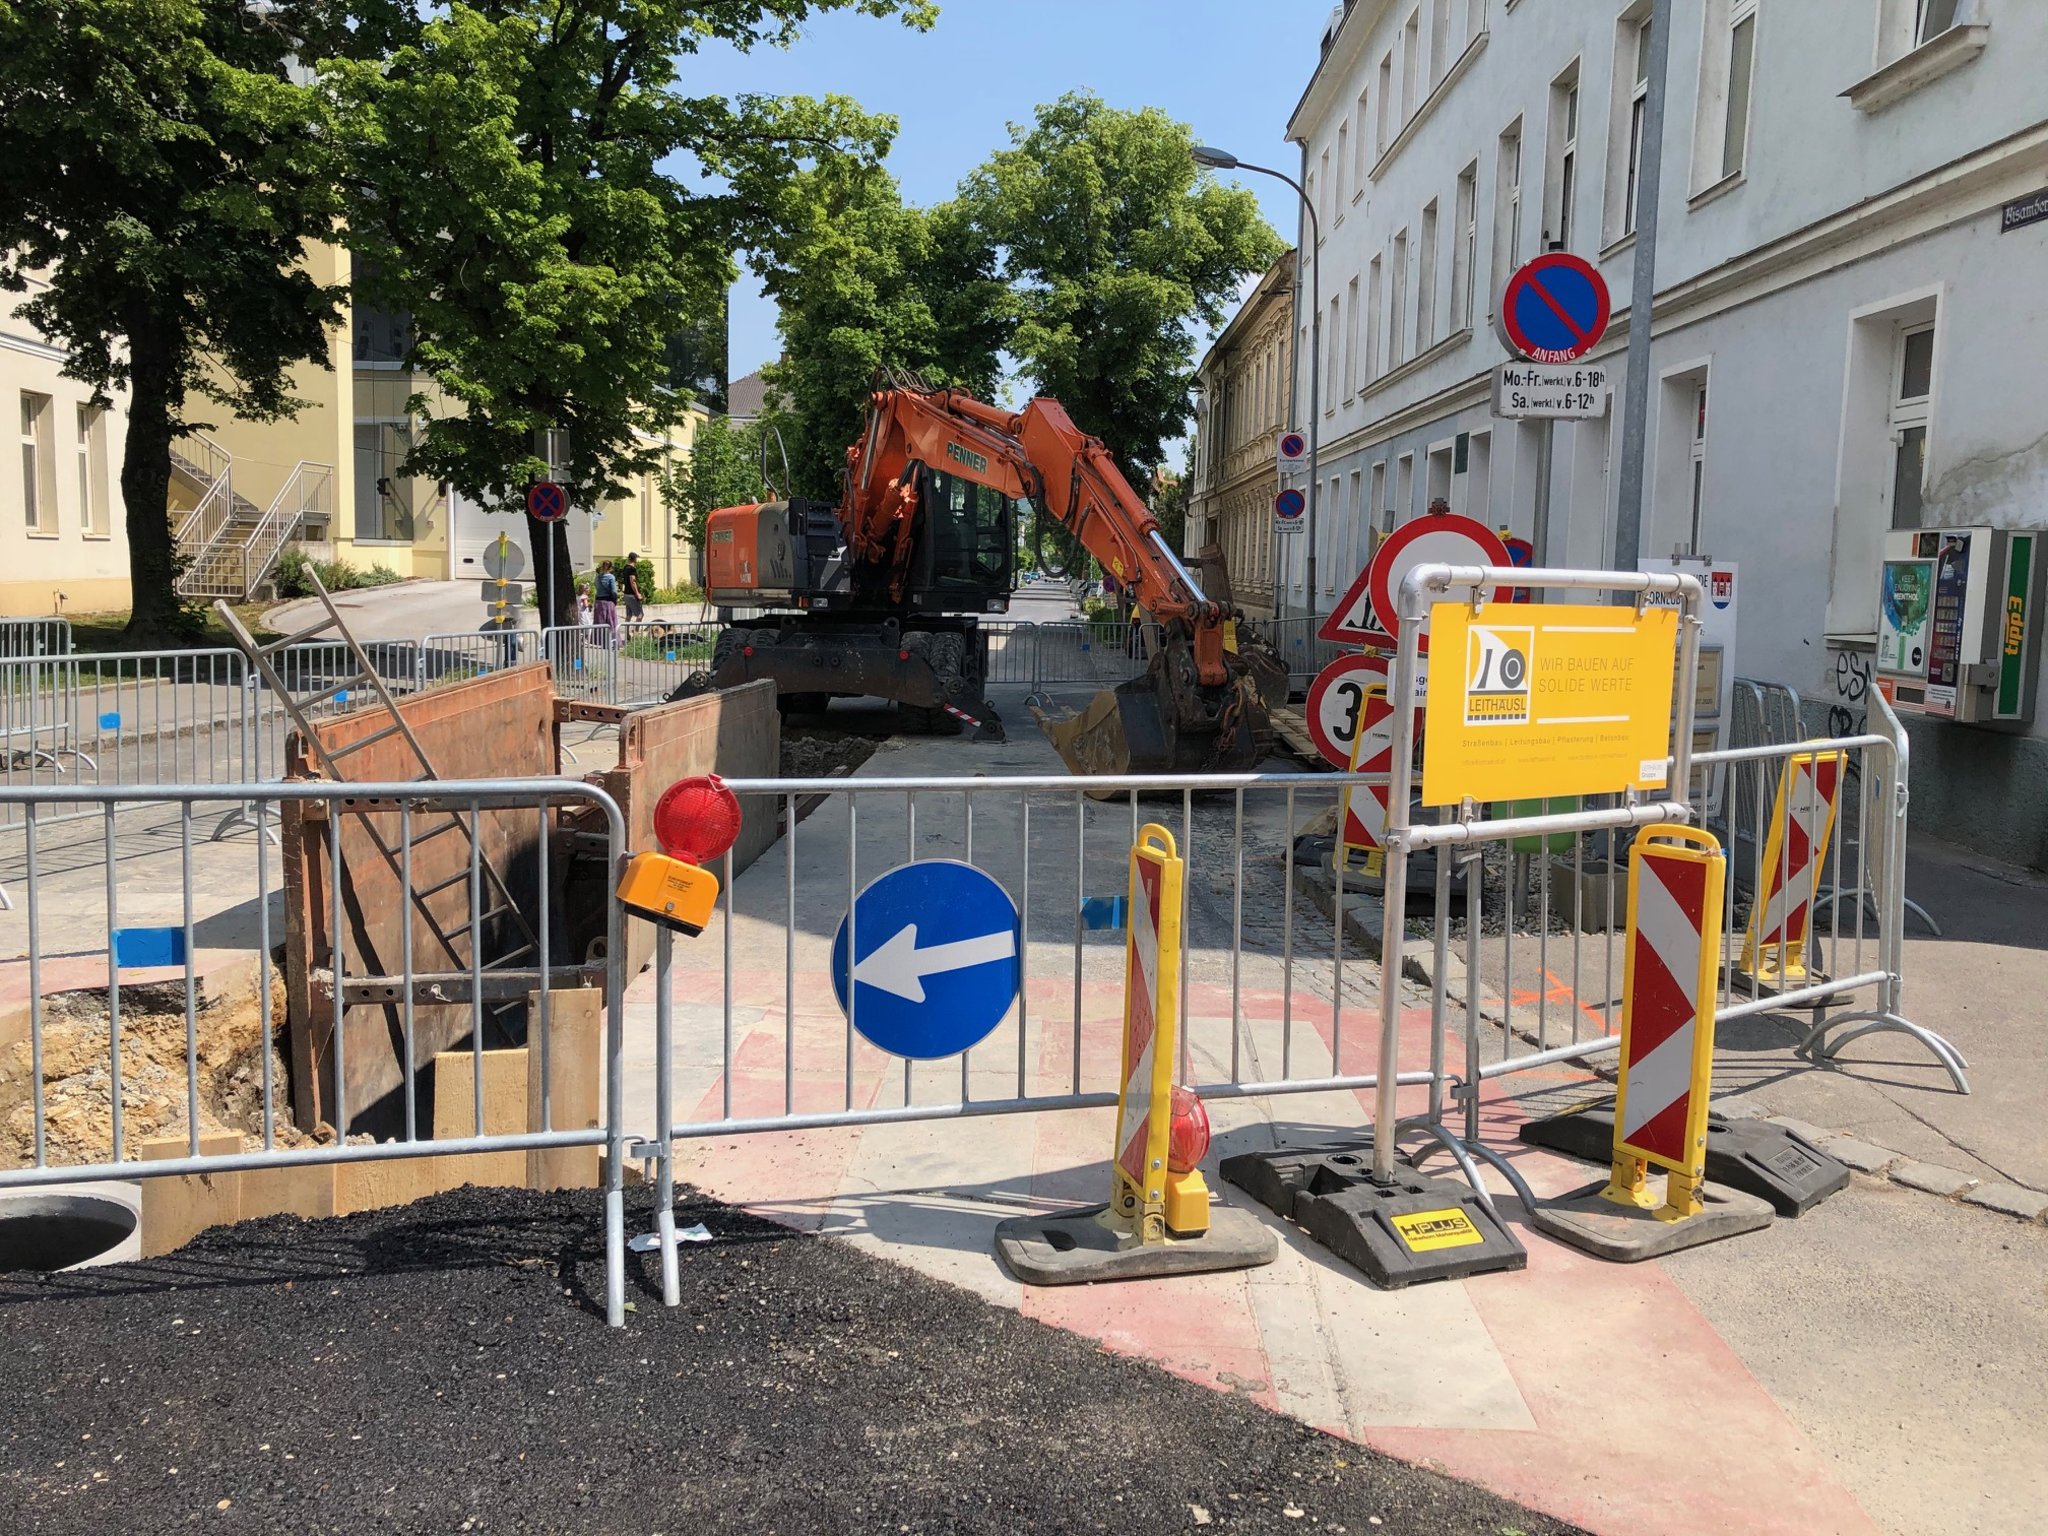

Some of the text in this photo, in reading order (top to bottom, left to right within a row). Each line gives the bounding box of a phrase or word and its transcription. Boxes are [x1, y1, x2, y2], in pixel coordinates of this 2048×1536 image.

[1531, 347, 1576, 363] ANFANG
[1511, 392, 1530, 409] Sa.
[946, 440, 988, 476] PENNER
[1893, 592, 1919, 601] MENTHOL
[2004, 595, 2025, 656] tipp3
[1540, 657, 1635, 672] WIR BAUEN AUF
[1538, 677, 1632, 693] SOLIDE WERTE
[1462, 738, 1503, 748] Straßenbau
